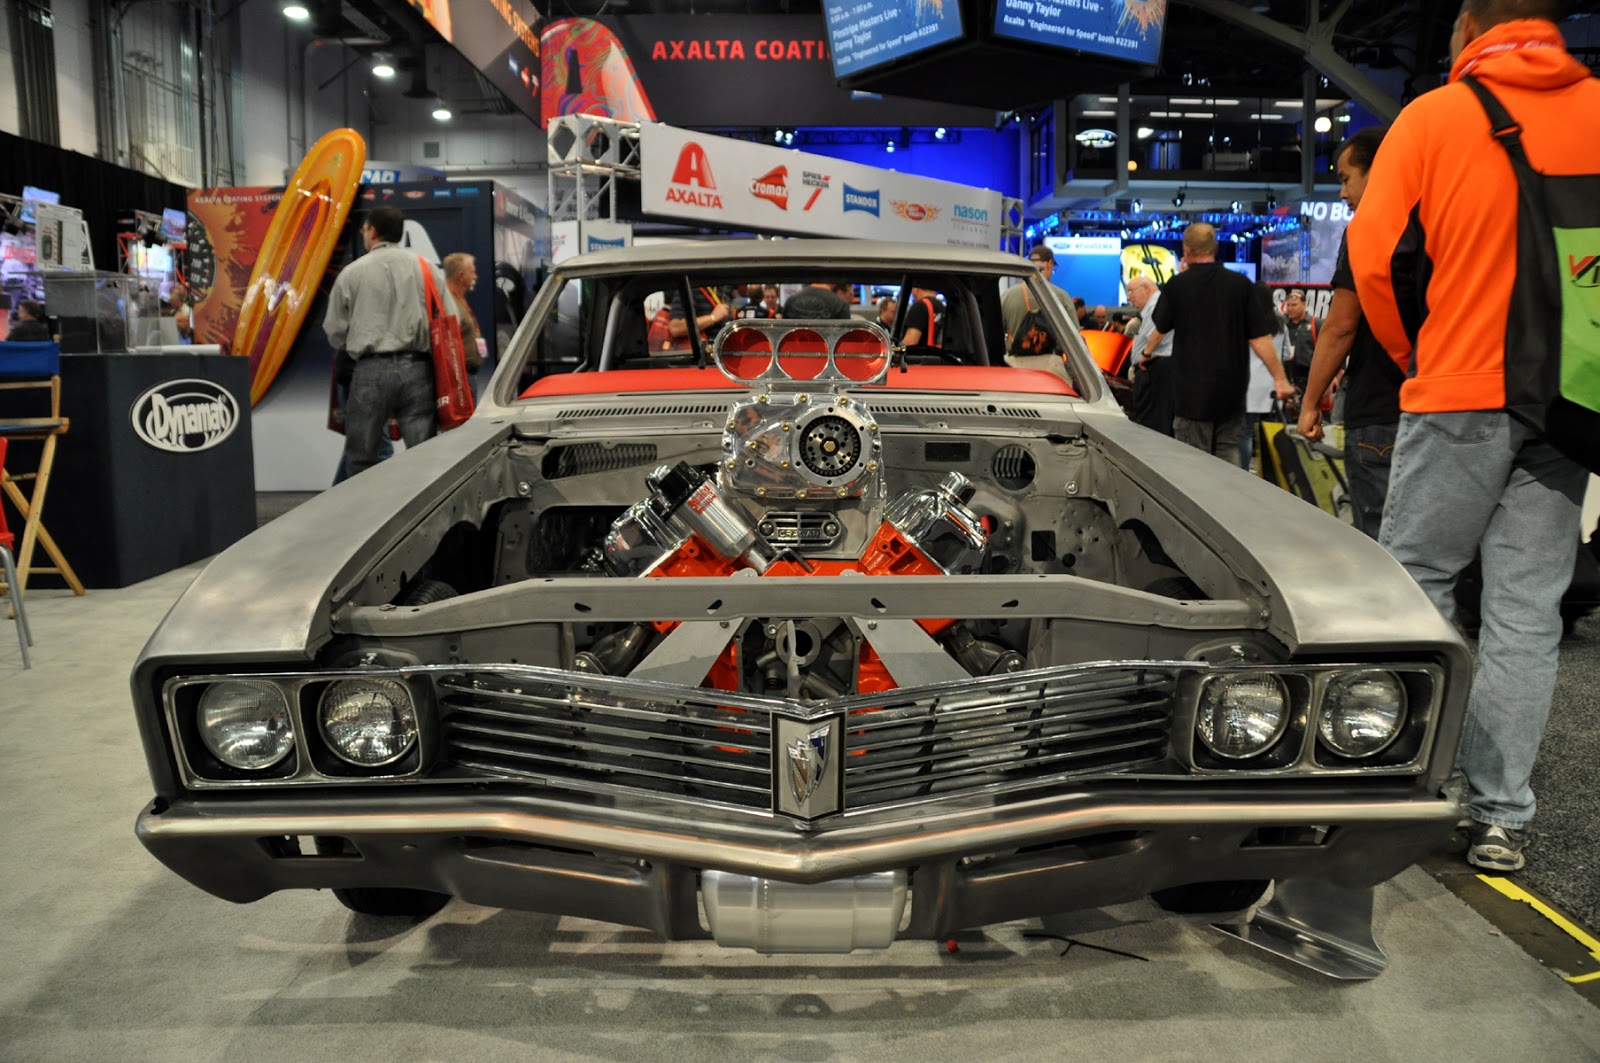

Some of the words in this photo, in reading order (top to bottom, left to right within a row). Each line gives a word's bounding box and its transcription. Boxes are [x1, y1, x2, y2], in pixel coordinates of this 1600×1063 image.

[1006, 0, 1034, 14] Danny
[1036, 2, 1061, 17] Taylor
[1082, 0, 1100, 12] Live
[859, 13, 884, 28] Masters
[883, 8, 898, 20] Live
[853, 31, 872, 45] Taylor
[903, 31, 918, 43] booth
[918, 23, 939, 36] #22391
[1004, 15, 1025, 27] Axalta
[1066, 26, 1075, 36] for
[1098, 33, 1115, 44] booth
[1116, 37, 1138, 48] #22391
[652, 40, 745, 60] AXALTA
[755, 40, 830, 60] COATI
[802, 170, 822, 180] SPIES
[802, 178, 830, 188] HECKER
[750, 180, 788, 198] Cromax
[223, 195, 253, 204] COATING
[665, 188, 723, 209] AXALTA
[845, 194, 878, 208] STANDOX
[954, 203, 988, 221] nason
[1300, 202, 1327, 220] NO
[151, 393, 226, 446] Dynamat
